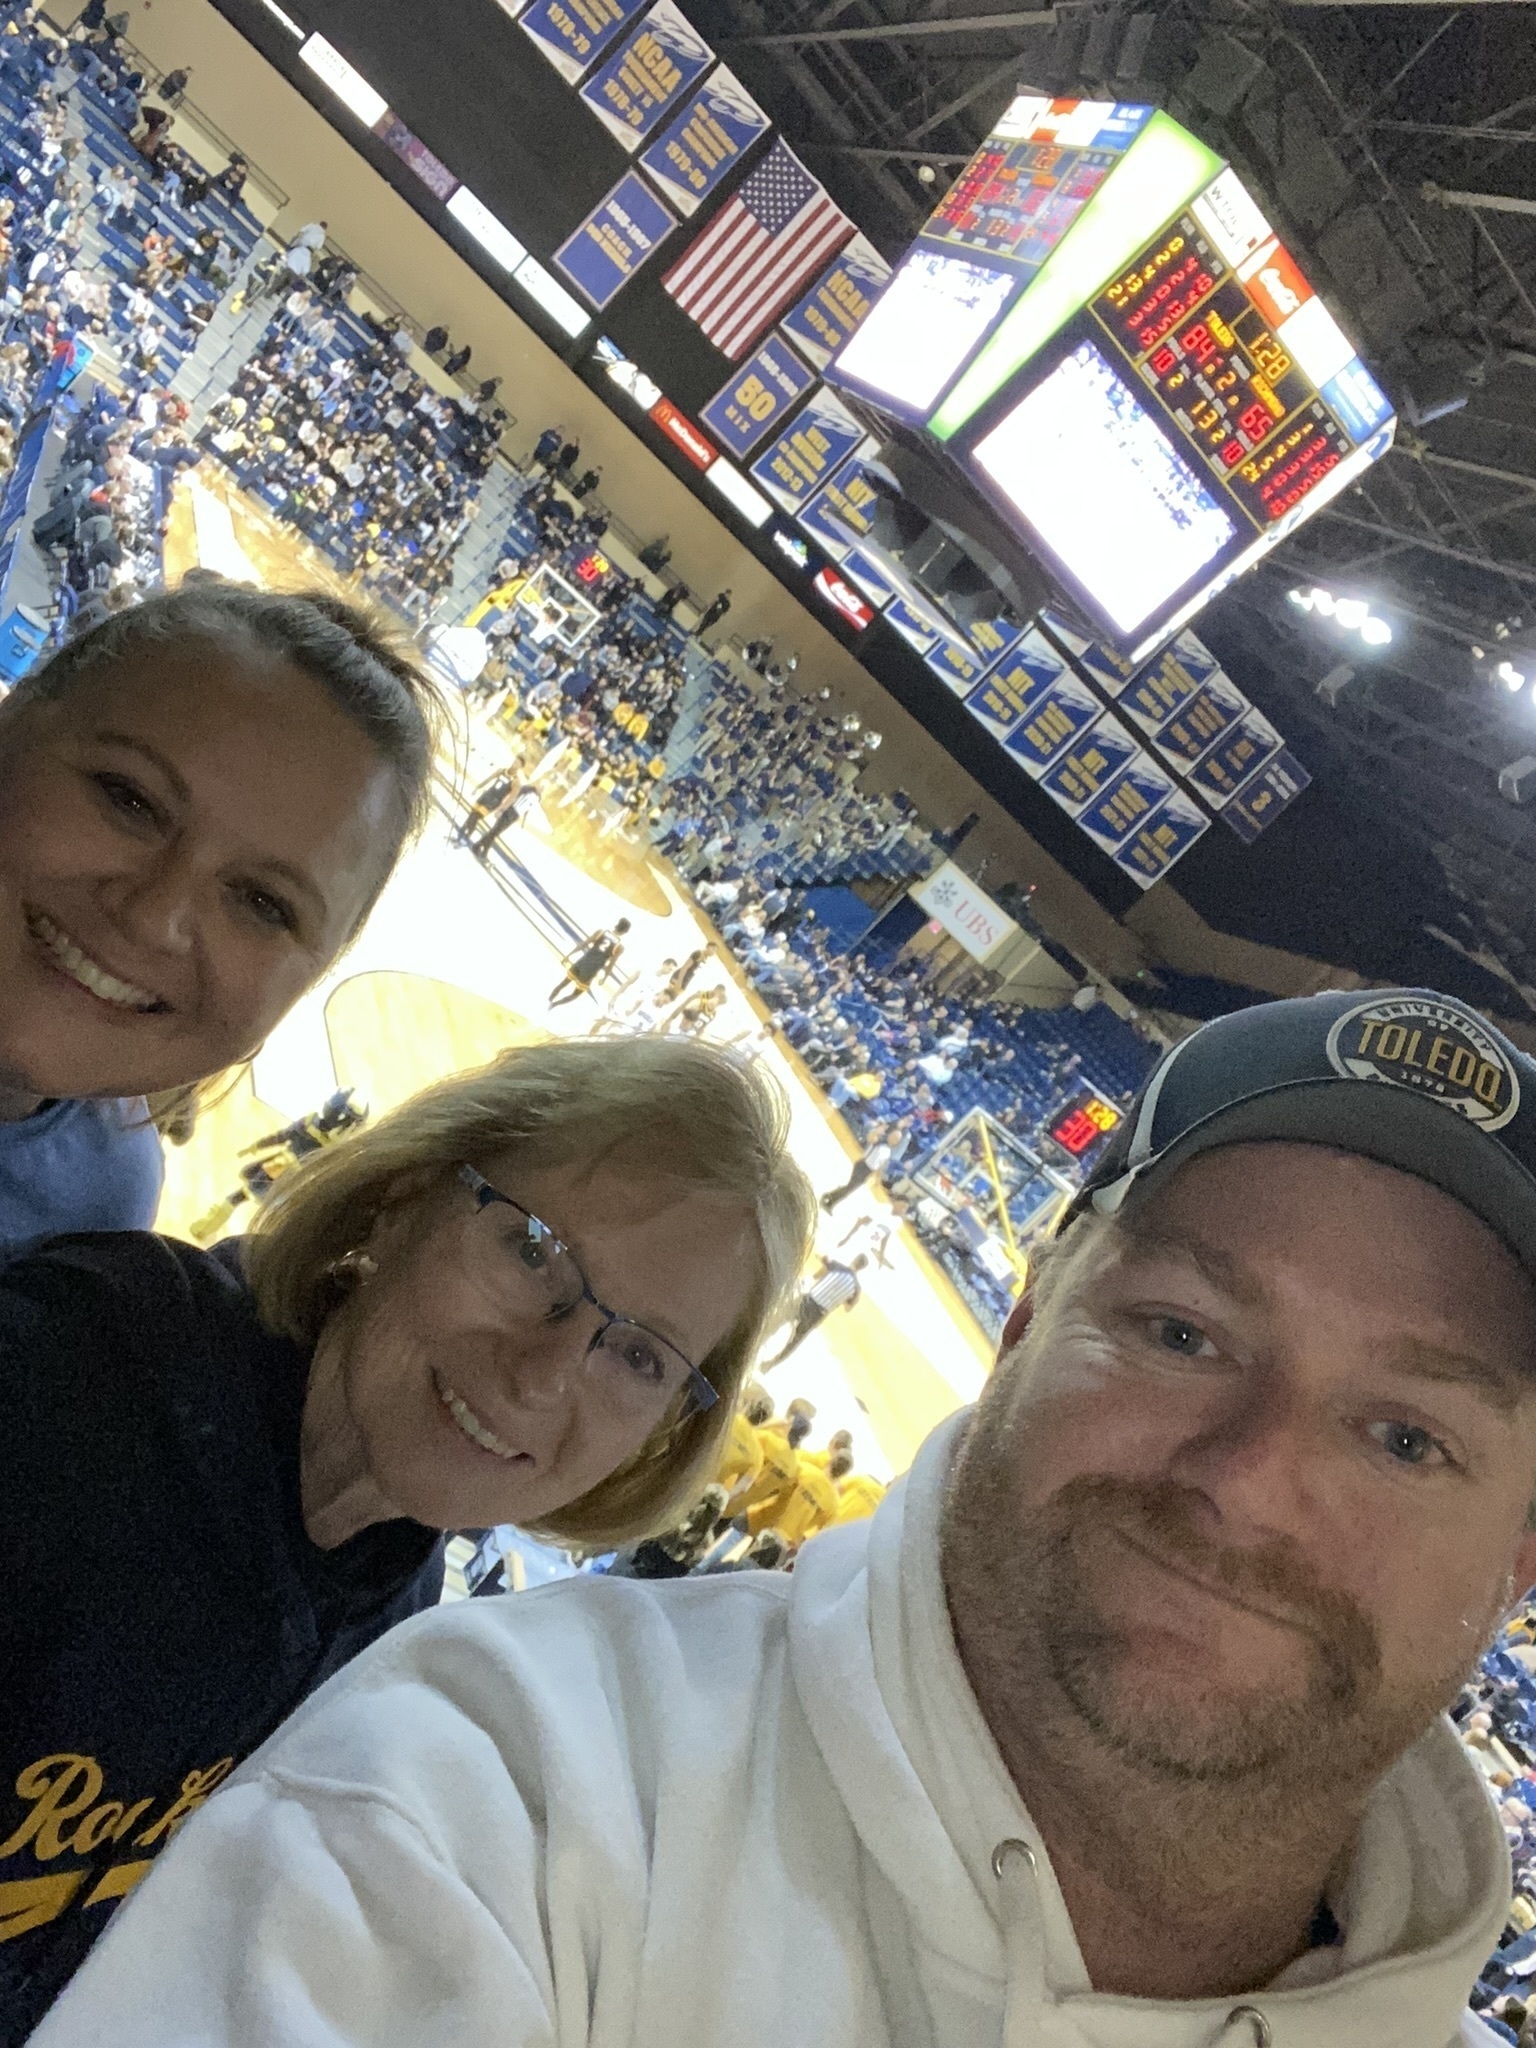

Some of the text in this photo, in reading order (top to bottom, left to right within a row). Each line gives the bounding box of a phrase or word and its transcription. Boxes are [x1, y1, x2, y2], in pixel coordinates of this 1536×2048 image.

[631, 31, 683, 93] NCAA
[1155, 250, 1198, 304] 2 2 4
[1167, 236, 1213, 291] 0 4 10
[826, 270, 870, 318] NCAA
[1107, 284, 1129, 306] 21
[1128, 312, 1143, 327] 3
[1139, 327, 1157, 345] 15
[1124, 274, 1172, 331] 13 3 5
[1141, 265, 1184, 318] 4 0 13
[1204, 309, 1286, 418] TOLEDO RICHMOND
[1248, 333, 1289, 377] 1:28
[733, 376, 777, 420] 50
[1182, 325, 1217, 362] 84
[1215, 371, 1236, 391] 2
[1240, 405, 1273, 438] 65
[1151, 349, 1174, 372] 10
[1168, 373, 1184, 388] 2
[1209, 428, 1225, 443] 2
[1221, 440, 1244, 463] 10
[667, 416, 711, 462] McDonald's
[1286, 432, 1301, 446] 3
[1298, 449, 1313, 463] 3
[1312, 436, 1327, 450] 3
[1323, 453, 1339, 468] 5
[1242, 462, 1261, 482] 24
[1259, 456, 1275, 470] 5
[1272, 472, 1287, 487] 0
[1273, 445, 1312, 492] 4 3 5
[576, 557, 599, 581] 30
[598, 938, 610, 952] 2
[954, 901, 997, 946] UBS
[1358, 1020, 1501, 1103] TOLEDO
[1054, 1109, 1099, 1152] 30
[1085, 1100, 1116, 1130] 1:28
